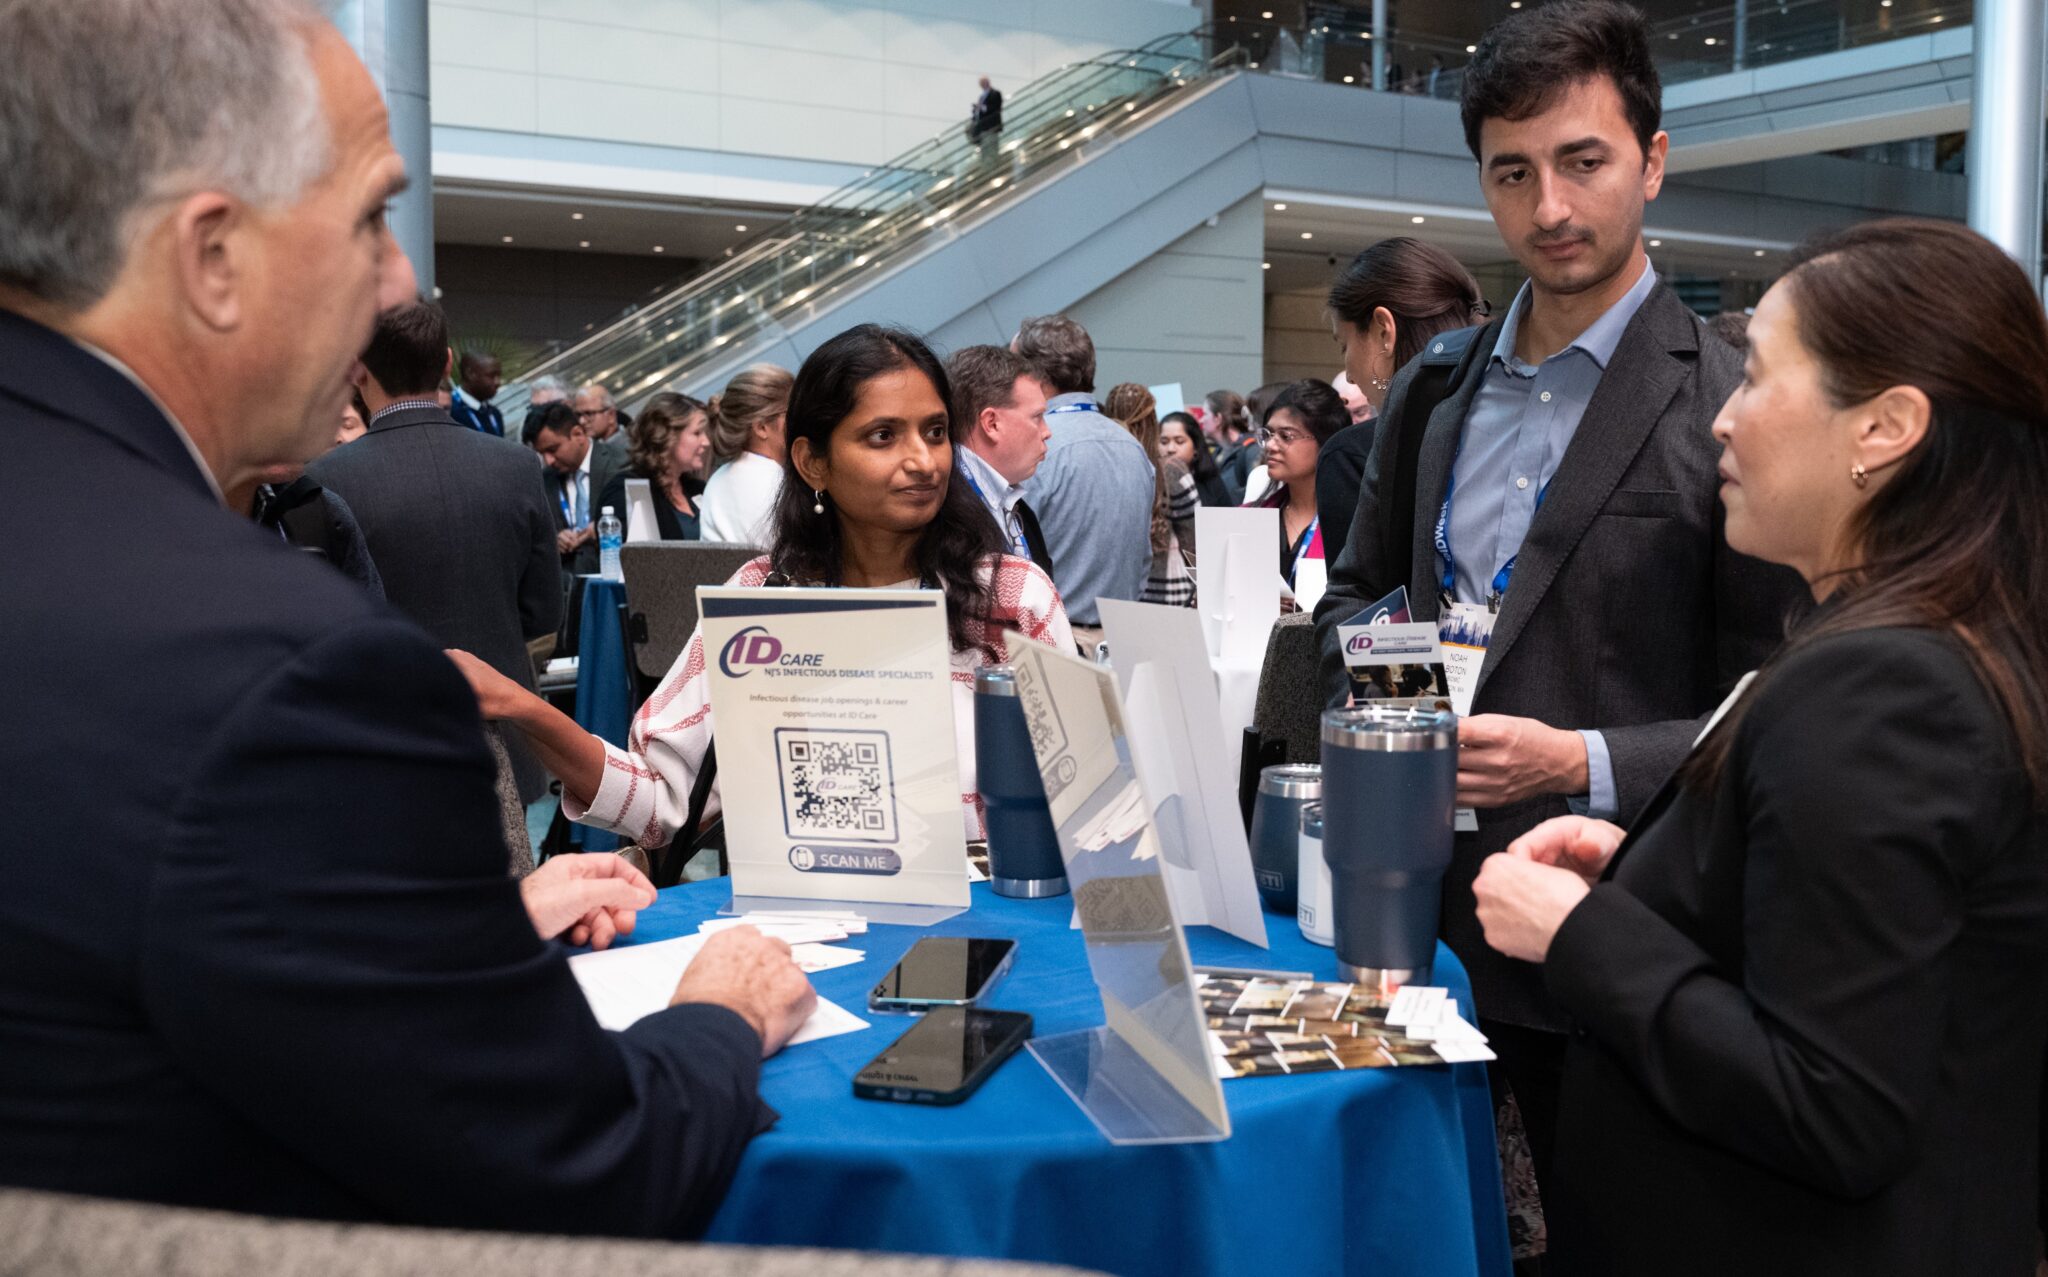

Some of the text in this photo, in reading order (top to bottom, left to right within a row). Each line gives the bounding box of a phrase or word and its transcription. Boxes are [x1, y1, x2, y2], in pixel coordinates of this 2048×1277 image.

[1434, 500, 1449, 553] IDWeek
[1351, 637, 1373, 650] ID
[729, 635, 825, 667] ID CARE
[783, 668, 838, 678] INFECTIOUS
[838, 669, 876, 679] DISEASE
[877, 670, 934, 680] SPECIALISTS
[749, 694, 789, 703] Infectious
[789, 694, 819, 703] disease
[820, 695, 834, 705] job
[836, 697, 873, 706] openings
[875, 697, 881, 705] &
[782, 711, 837, 720] opportunities
[848, 711, 858, 720] ID
[859, 712, 877, 720] Care
[820, 853, 888, 869] SCAN ME
